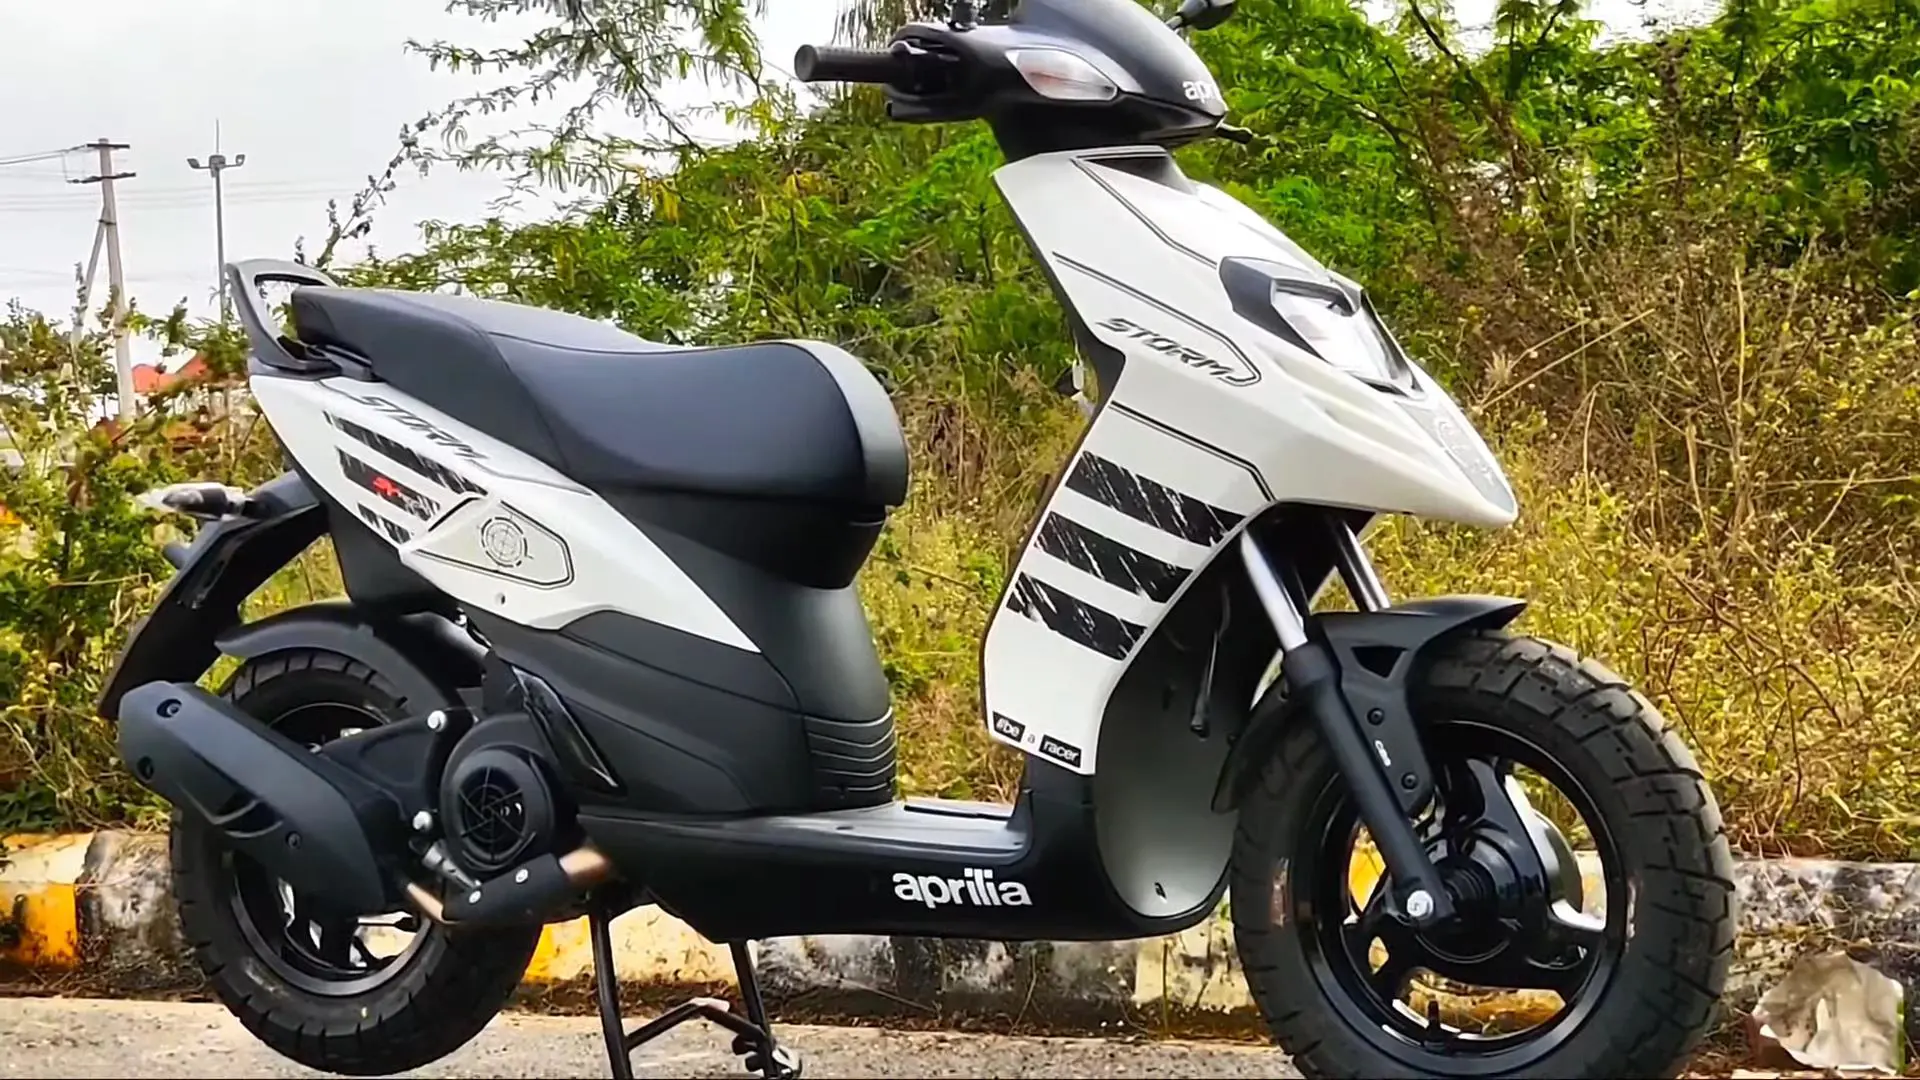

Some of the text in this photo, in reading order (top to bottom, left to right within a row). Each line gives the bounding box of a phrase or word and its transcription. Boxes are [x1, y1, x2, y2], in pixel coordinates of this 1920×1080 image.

[1095, 318, 1234, 376] STORM
[358, 397, 489, 460] STORM
[1027, 733, 1036, 744] a
[1043, 740, 1079, 761] racer
[892, 867, 1033, 909] aprilia
